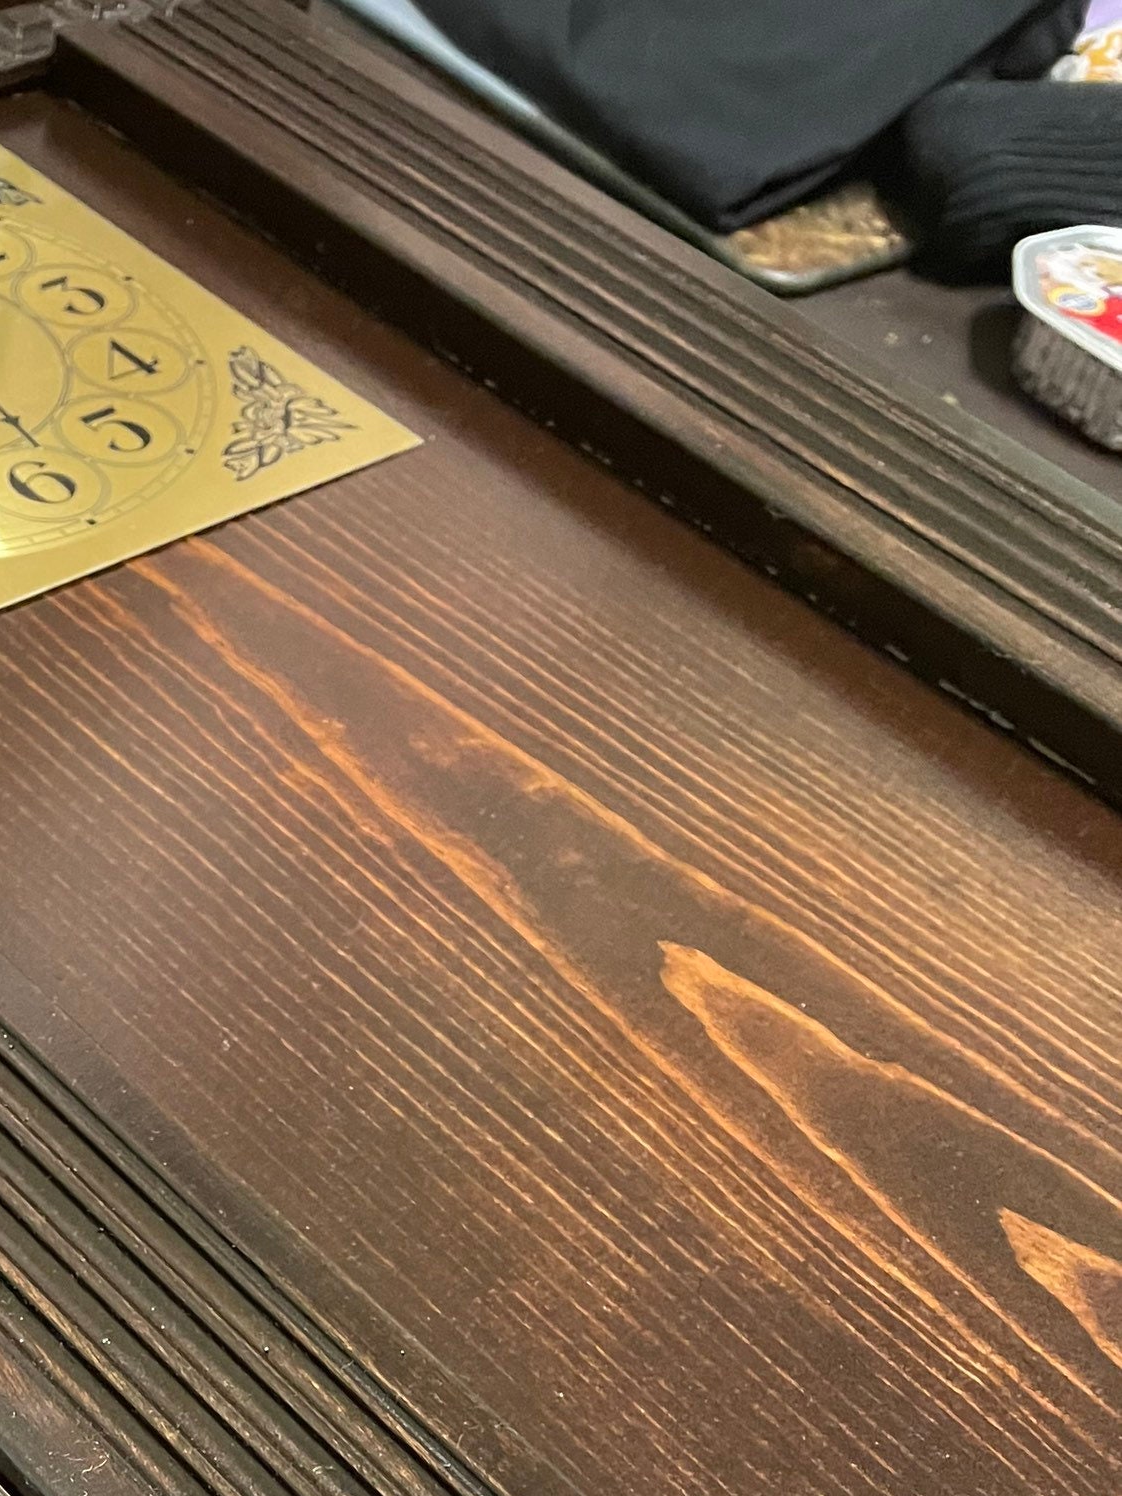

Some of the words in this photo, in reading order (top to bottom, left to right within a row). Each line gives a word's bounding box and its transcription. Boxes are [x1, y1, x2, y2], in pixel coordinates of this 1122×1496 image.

[41, 275, 105, 315] 3
[106, 339, 162, 380] 4
[82, 406, 151, 452] 5
[8, 460, 77, 505] 6
